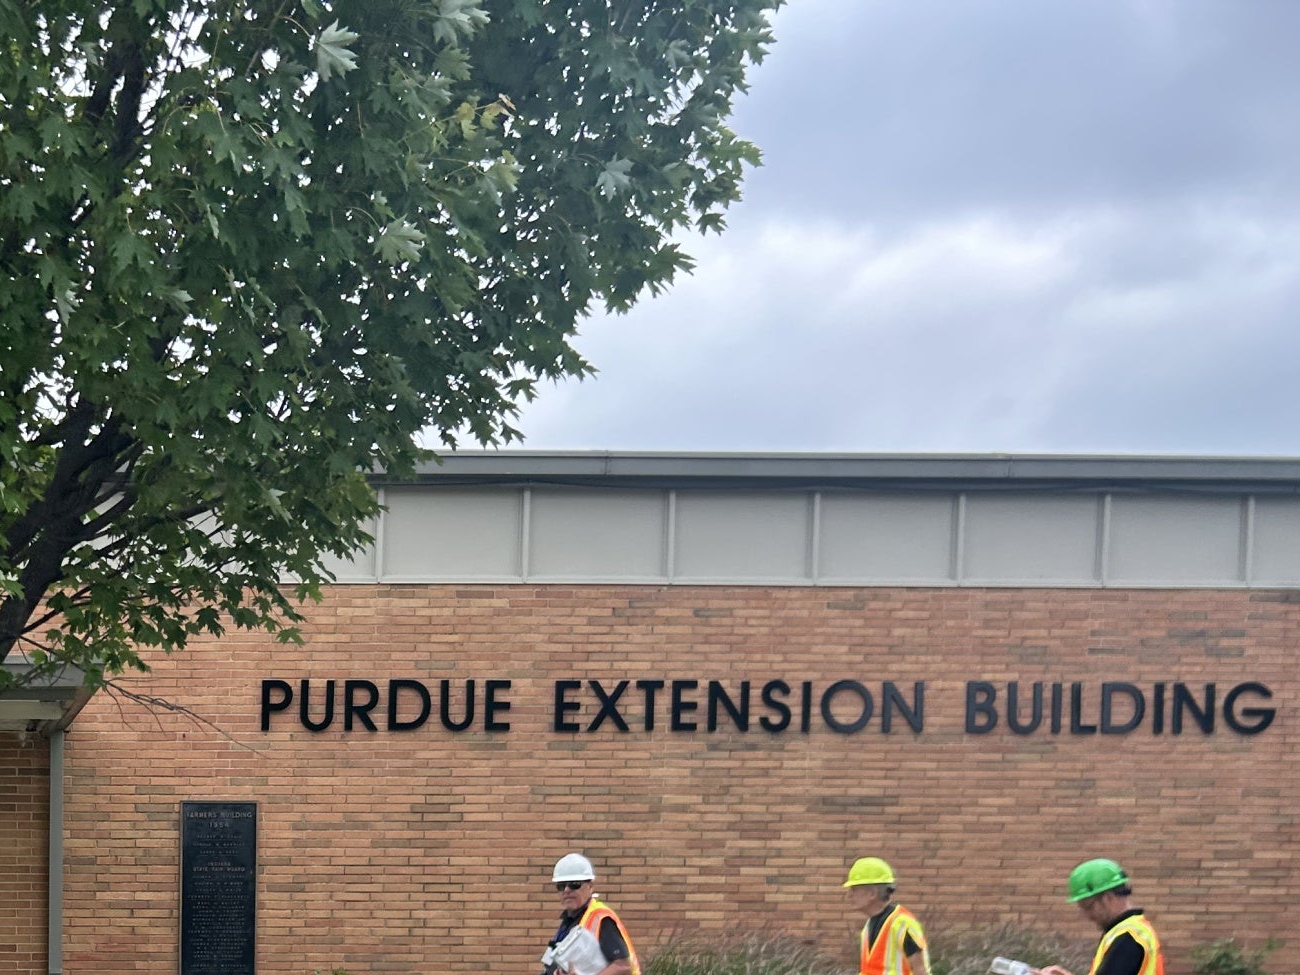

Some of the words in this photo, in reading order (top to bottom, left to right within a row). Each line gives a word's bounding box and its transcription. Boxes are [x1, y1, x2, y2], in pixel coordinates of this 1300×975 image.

[261, 679, 512, 734] PURDUE
[553, 679, 924, 735] EXTENSION
[965, 681, 1277, 738] BUILDING
